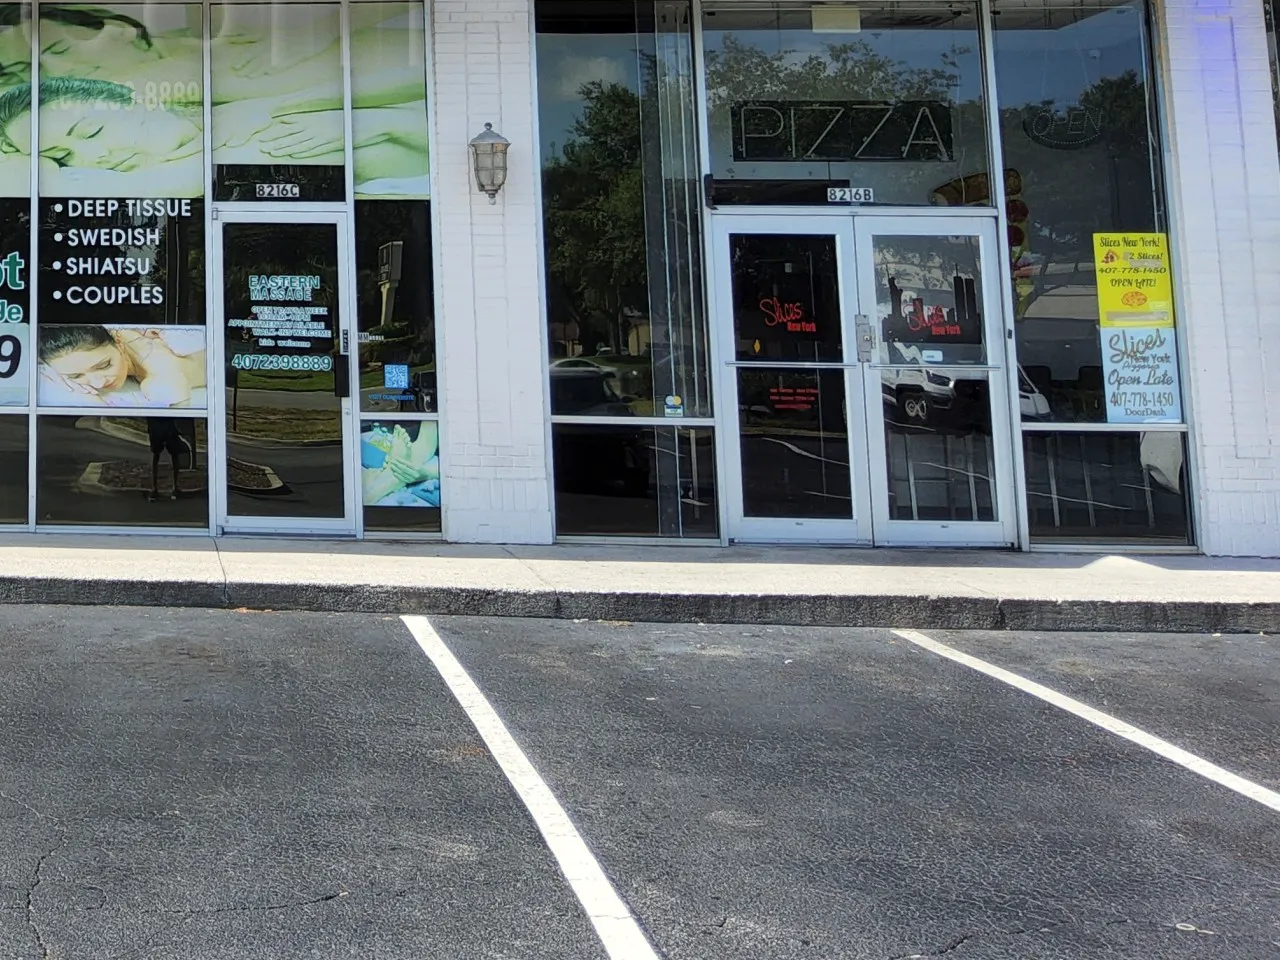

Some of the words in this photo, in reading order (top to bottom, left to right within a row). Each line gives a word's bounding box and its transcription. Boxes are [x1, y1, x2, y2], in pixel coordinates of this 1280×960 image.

[1032, 110, 1102, 136] OPEN
[740, 105, 950, 161] PIZZA
[257, 184, 298, 197] 8216C
[828, 189, 872, 202] 8216B
[68, 199, 119, 217] DEEP
[125, 199, 191, 217] TISSUE
[67, 228, 159, 246] SWEDISH
[1100, 236, 1120, 247] Slices
[1121, 236, 1137, 247] New
[1139, 236, 1159, 247] York!
[1137, 252, 1163, 260] Slices!
[66, 257, 150, 275] SHIATSU
[248, 275, 321, 289] EASTERN
[66, 286, 163, 304] COUPLES
[249, 288, 312, 301] MASSAGE
[292, 329, 332, 338] WELCOME
[787, 322, 801, 331] New
[801, 322, 816, 332] York
[1109, 328, 1166, 363] Slices
[231, 354, 332, 371] 4072398889
[1150, 353, 1172, 363] York
[1108, 368, 1142, 390] Open
[1143, 369, 1174, 385] Late
[1110, 392, 1174, 407] 407-778-1450
[1124, 407, 1166, 416] DoorDash
